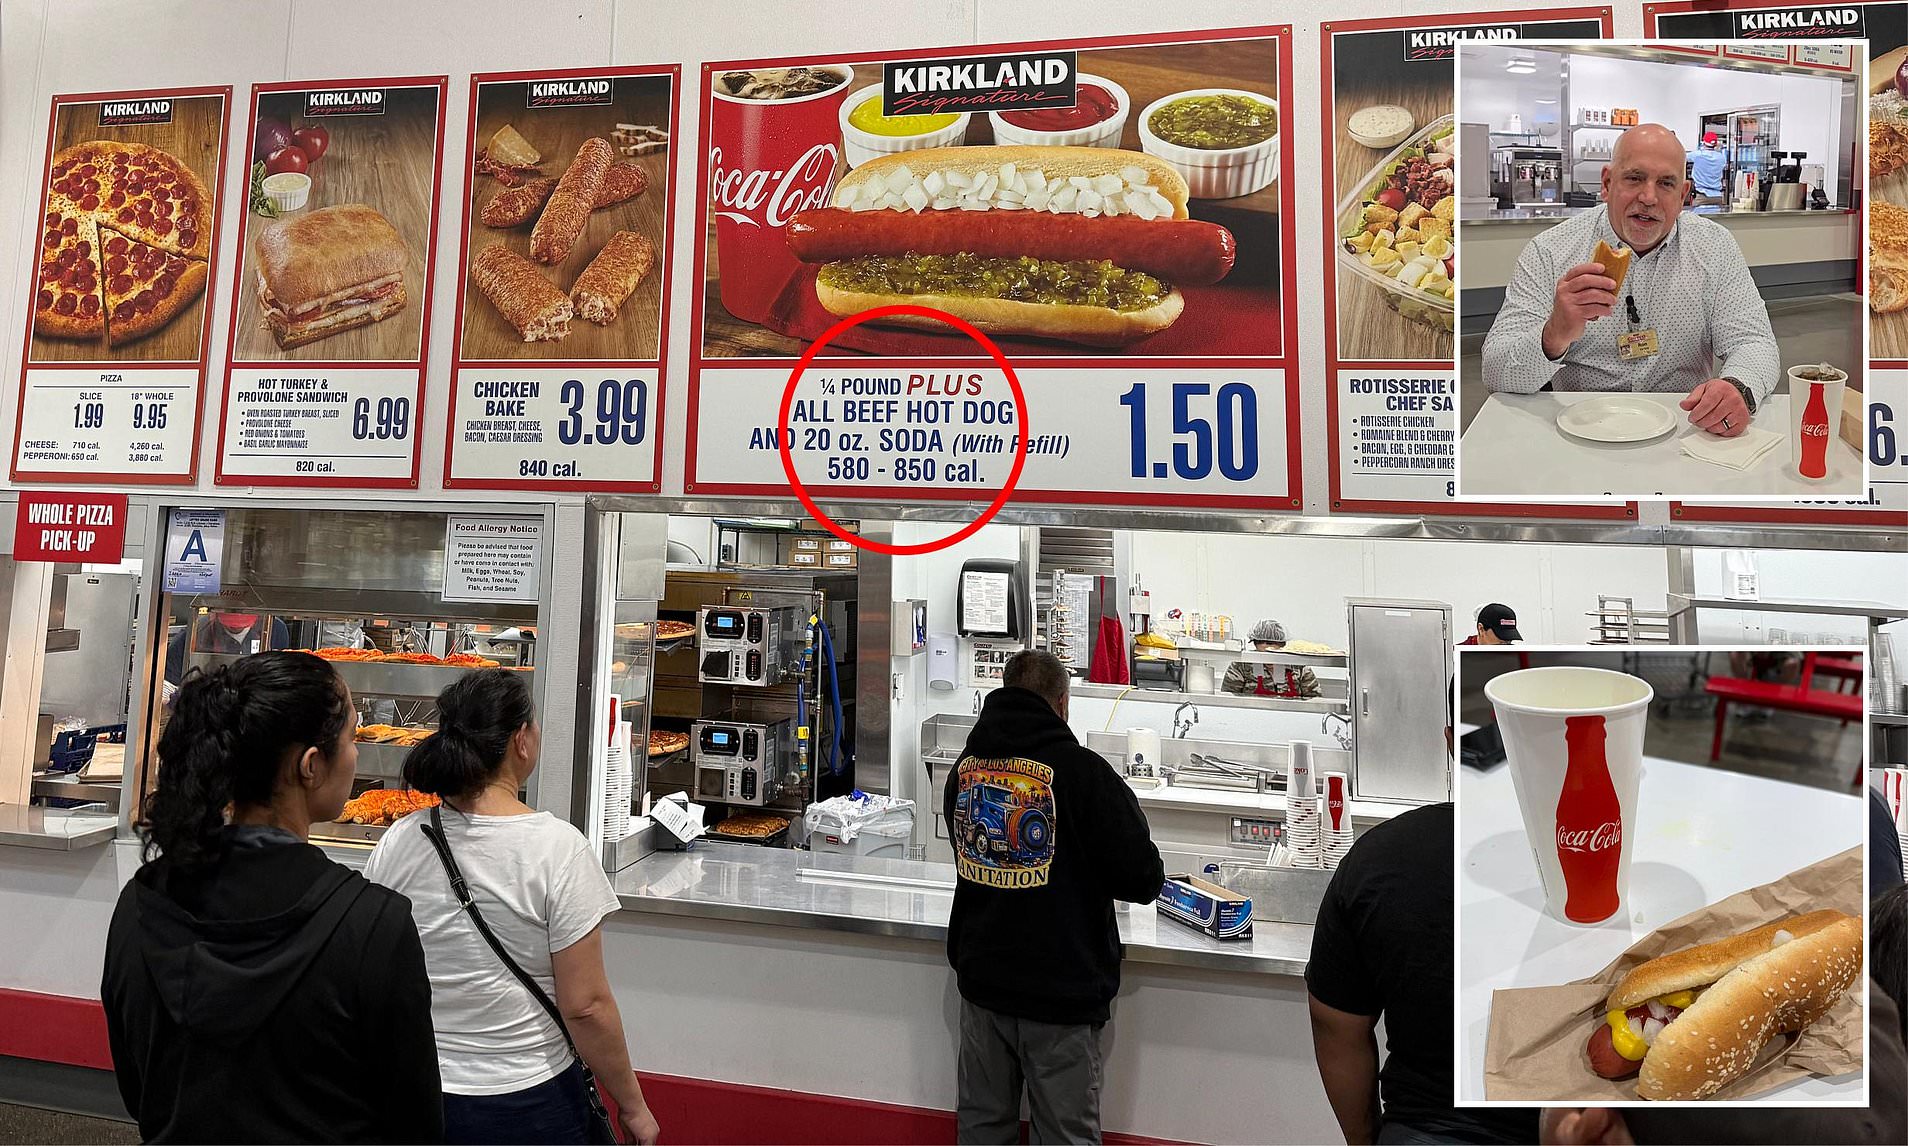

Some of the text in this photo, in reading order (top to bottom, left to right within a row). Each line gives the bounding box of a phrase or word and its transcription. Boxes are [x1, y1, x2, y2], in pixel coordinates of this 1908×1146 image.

[1741, 9, 1859, 30] KIRKLAND
[1411, 28, 1518, 48] KIRKLAND
[1742, 26, 1860, 39] Signature
[894, 58, 1069, 93] KIRKLAND
[532, 81, 610, 97] KIRKLAND
[309, 91, 382, 106] KIRKLAND
[532, 95, 609, 106] Signature
[893, 88, 1069, 115] Signature
[104, 101, 170, 116] KIRKLAND
[309, 105, 380, 115] Signature
[100, 374, 123, 383] PIZZA
[258, 378, 329, 390] HOT TURKEY &
[841, 378, 901, 395] POUND
[906, 374, 983, 396] PLUS
[474, 381, 540, 398] CHICKEN
[1350, 379, 1446, 394] ROTISSERIE
[79, 392, 103, 400] SLICE
[145, 392, 174, 401] WHOLE
[237, 391, 348, 403] PROVOLONE SANDWICH
[1386, 396, 1427, 411] CHEF
[73, 403, 104, 429] 1.99
[133, 403, 168, 429] 9.95
[246, 409, 339, 419] OVEN ROASTED TURKEY BREAST, SLICED
[485, 400, 525, 417] BAKE
[558, 379, 648, 445] 3.99
[792, 400, 1014, 425] ALL BEEF HOT DOG
[245, 418, 292, 428] PROVOLONE CHEESE
[352, 397, 410, 440] 6.99
[1360, 416, 1435, 428] ROTISSERIE CHICKEN
[244, 429, 305, 438] RED ONIONS & TOMATOES
[466, 421, 542, 432] CHICKEN BREAST, CHEESE,
[1119, 381, 1259, 481] 1.50
[464, 432, 543, 443] BACON, CAESAR DRESSING
[750, 427, 796, 450] AND
[804, 428, 830, 451] 20
[839, 432, 870, 451] oz.
[879, 429, 944, 452] SODA
[952, 433, 1003, 457] (With
[1361, 429, 1454, 442] ROMAINE BLEND & CHERRY
[24, 440, 101, 450] CHEESE: 710 cal.
[129, 442, 165, 451] 4,260 cal.
[243, 440, 308, 449] BASIL GARLIC MAYONNAISE
[1362, 443, 1389, 455] BACON,
[1390, 444, 1407, 455] EGG,
[1407, 444, 1412, 455] &
[1414, 444, 1447, 455] CHEDDAR
[23, 452, 100, 461] PEPPERONI: 650 cal.
[150, 454, 164, 462] cal.
[1362, 456, 1409, 468] PEPPERCORN
[1410, 457, 1436, 469] RANCH
[295, 461, 336, 473] 820 cal.
[519, 460, 582, 477] 840 cal.
[827, 457, 869, 481] 580
[894, 457, 936, 482] 850
[945, 459, 985, 483] cal.
[28, 503, 113, 526] WHOLE PIZZA
[455, 523, 538, 533] Food Allergy Notice
[40, 529, 96, 552] PICK-UP
[180, 529, 207, 562] A
[960, 758, 979, 774] CITY
[988, 758, 1004, 770] LOS
[1005, 758, 1052, 783] ANGELES
[1557, 818, 1620, 853] Coca-Cola
[960, 857, 1048, 886] ANITATION
